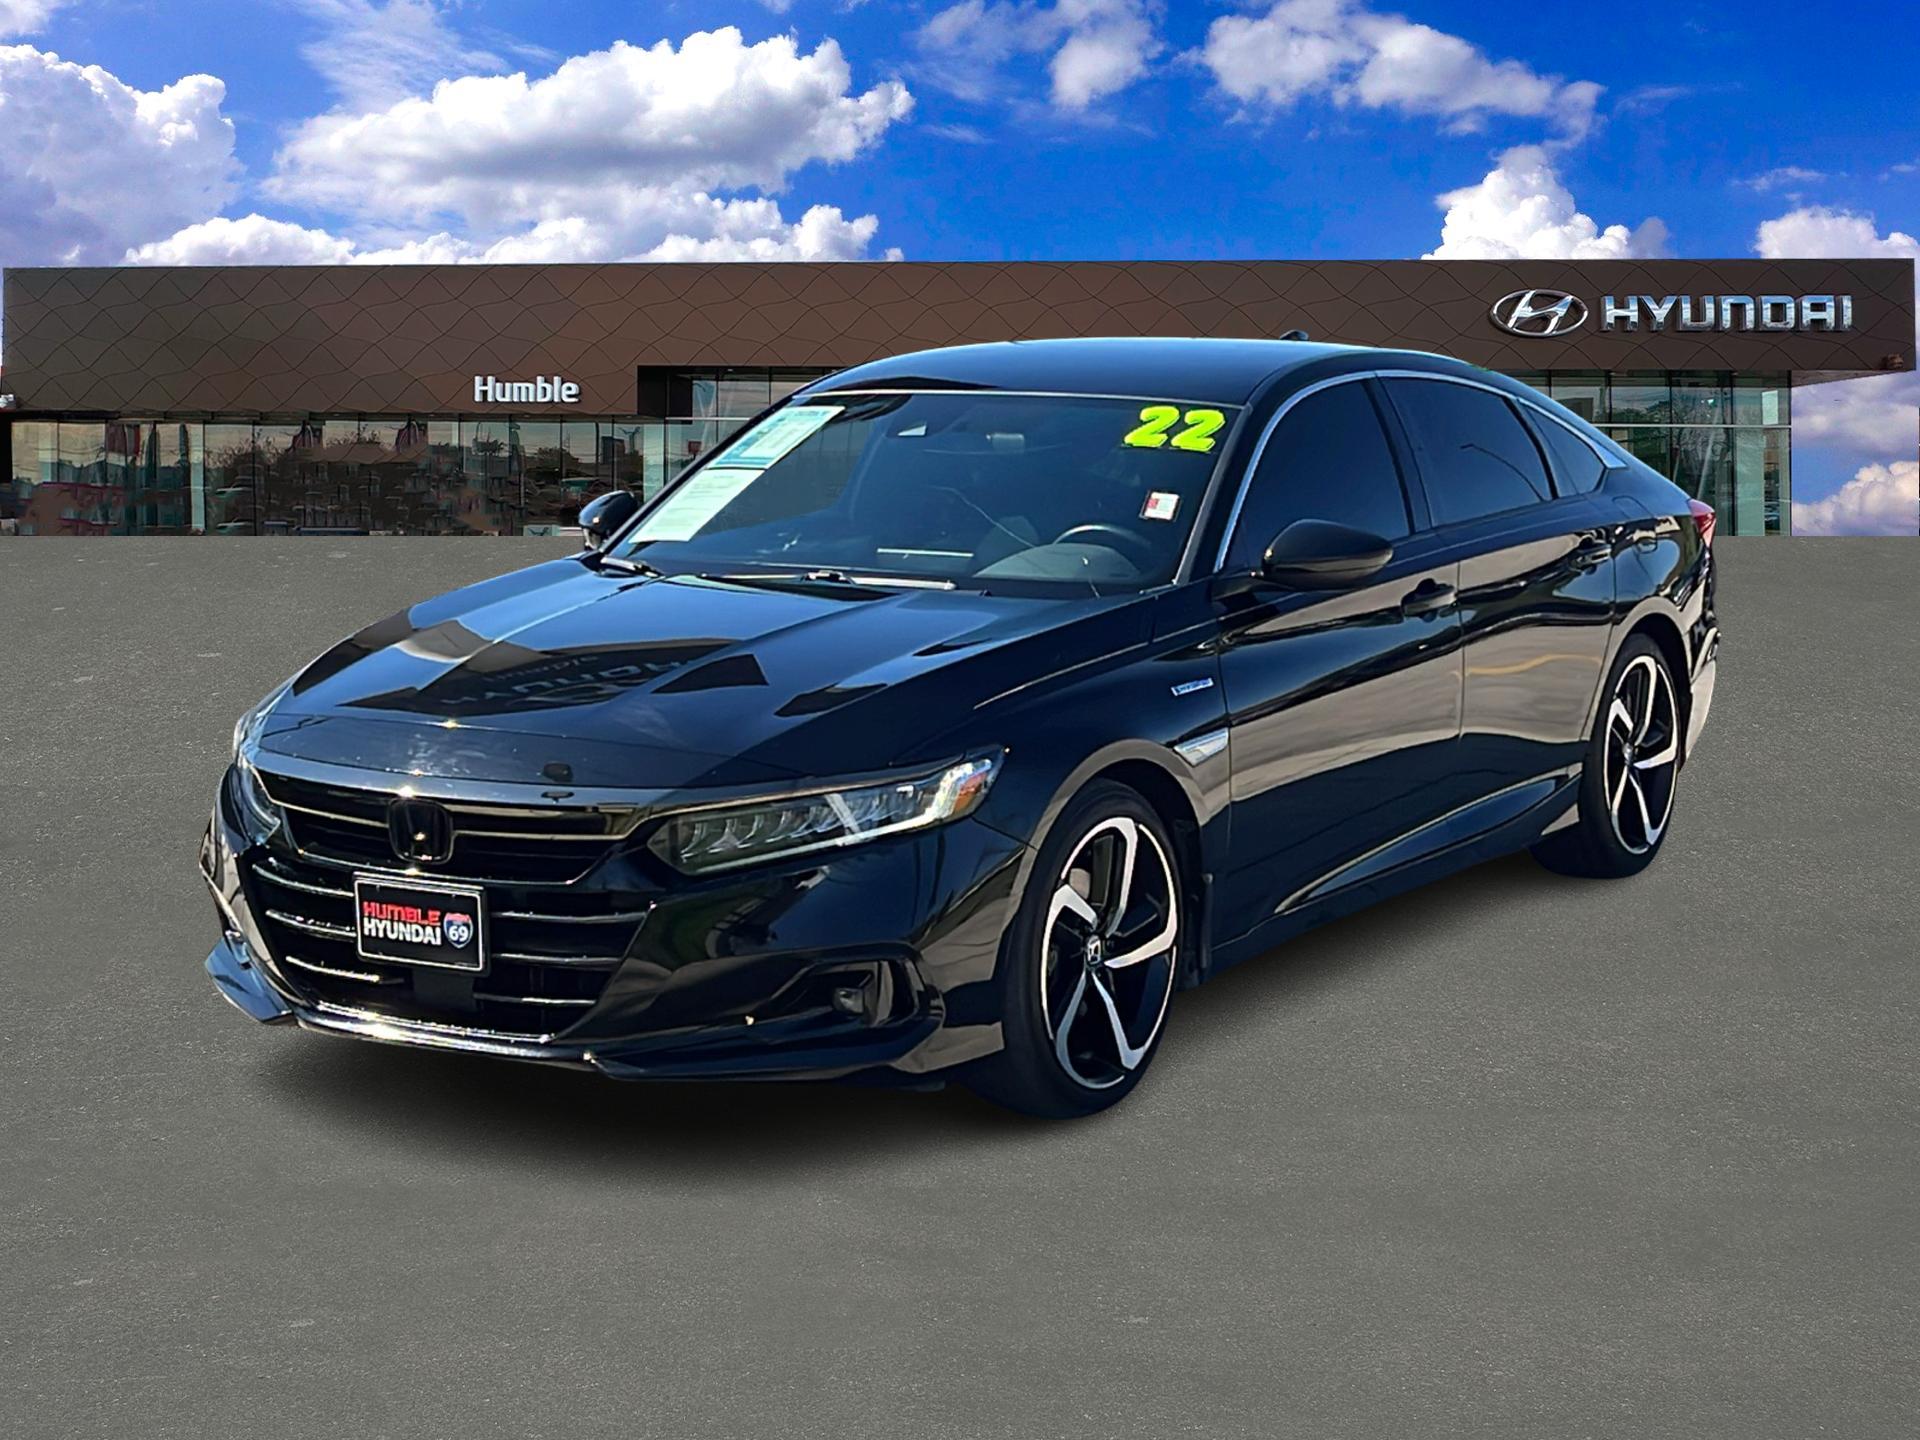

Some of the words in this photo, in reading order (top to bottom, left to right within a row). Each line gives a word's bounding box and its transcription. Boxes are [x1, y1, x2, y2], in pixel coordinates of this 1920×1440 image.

[1600, 294, 1854, 332] HYUNDAI
[474, 375, 580, 403] Humble
[1124, 405, 1226, 452] 22
[363, 901, 442, 927] HUMBLE
[363, 917, 442, 946] HYUNDAI
[448, 925, 469, 942] 69
